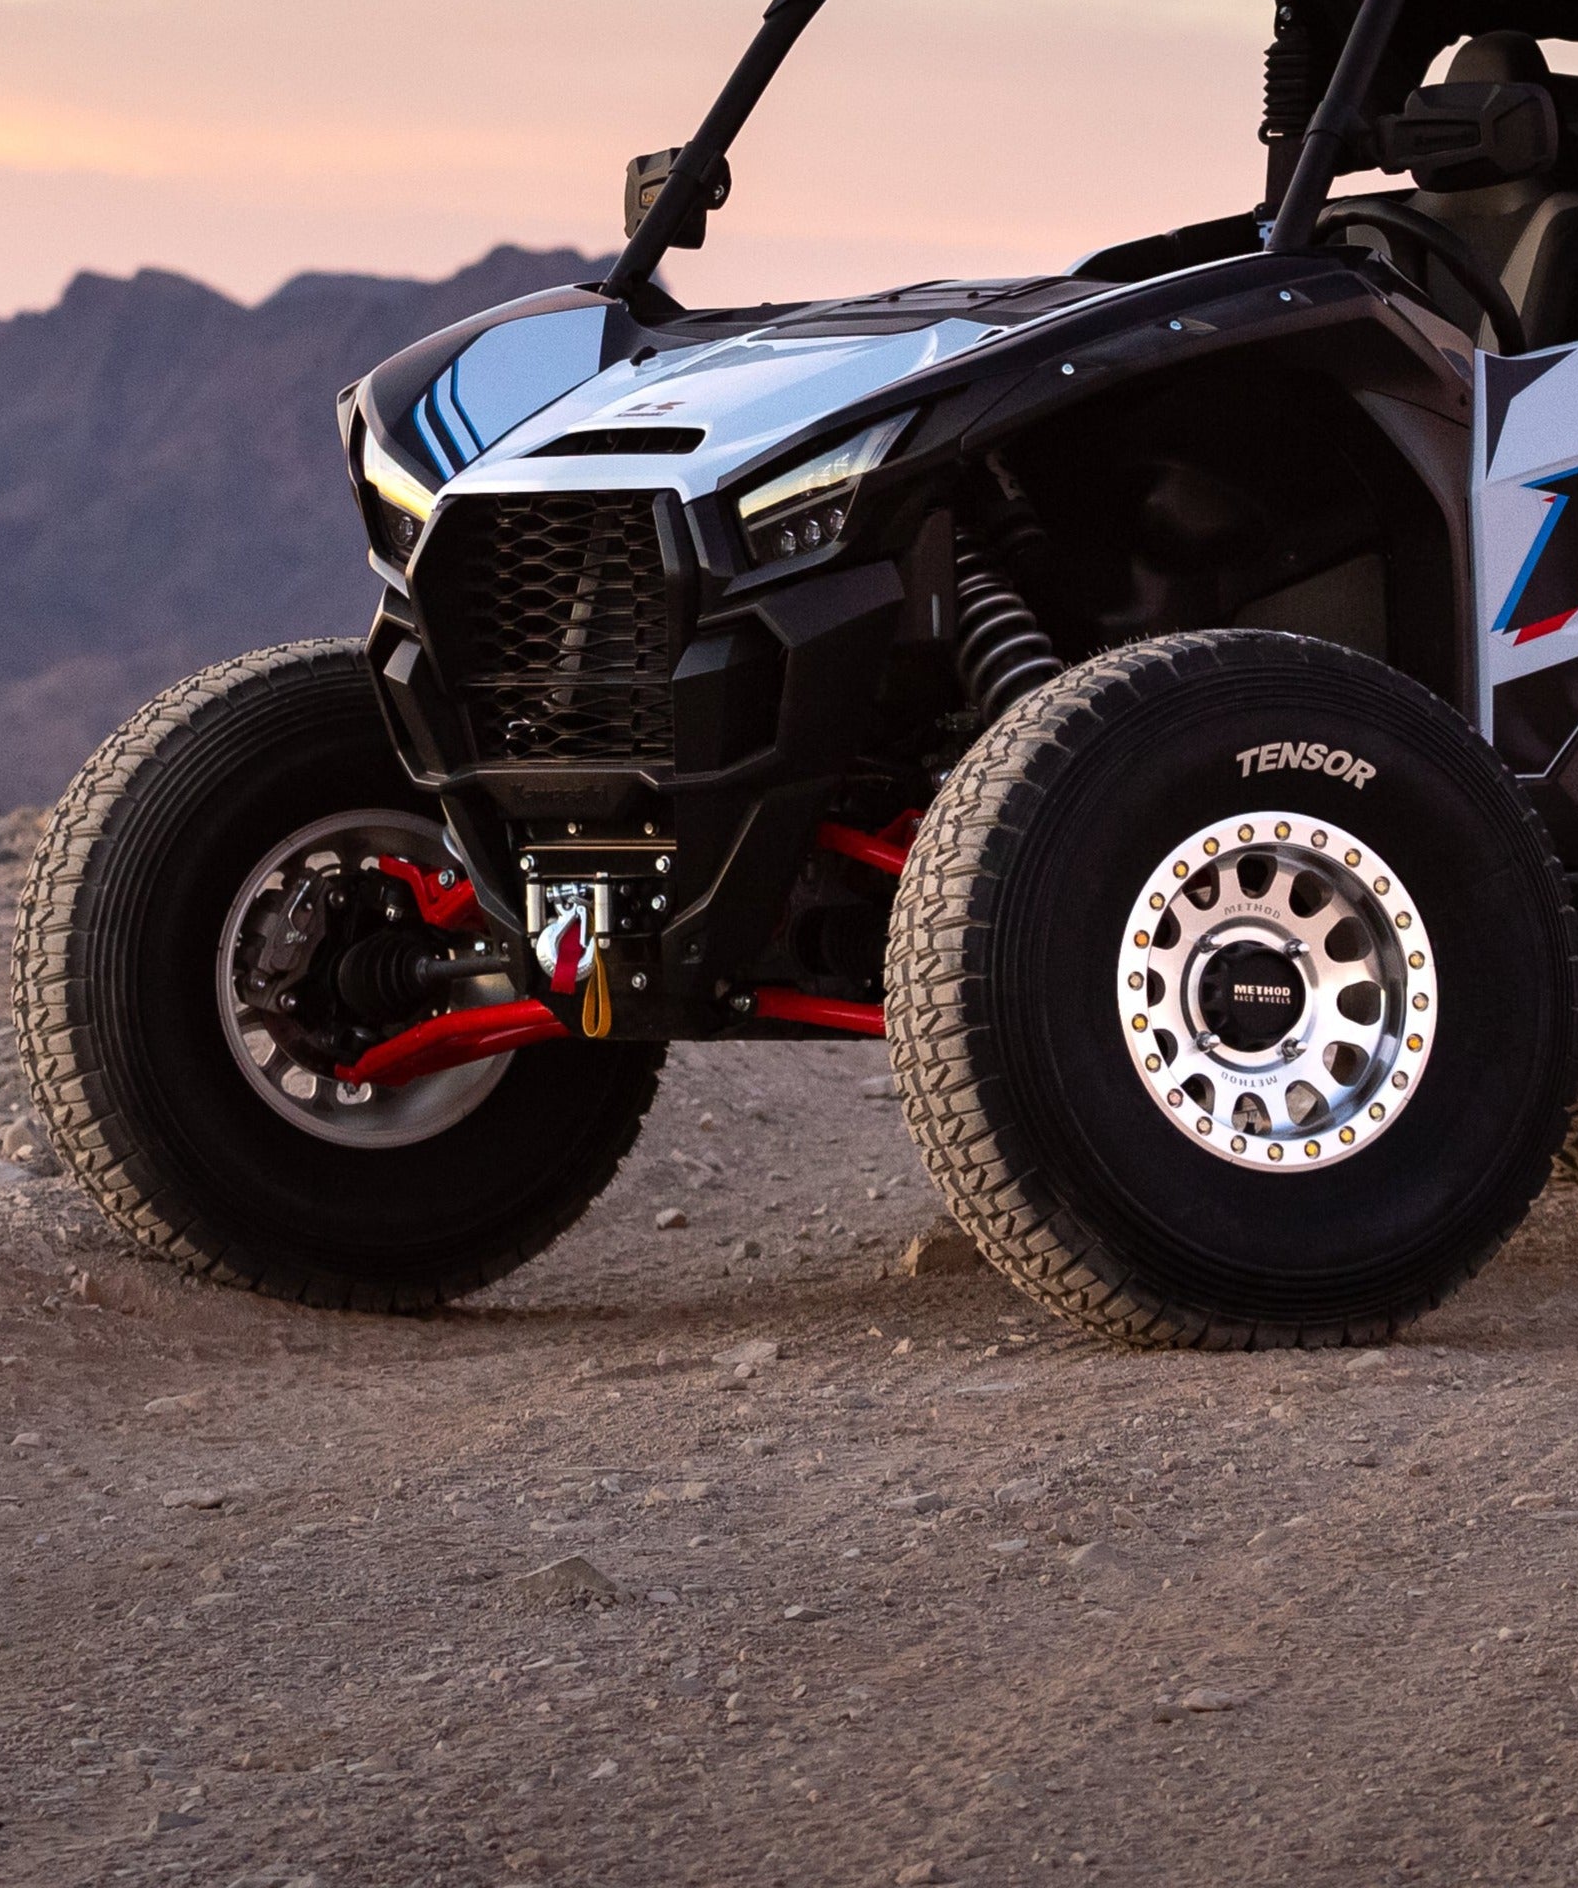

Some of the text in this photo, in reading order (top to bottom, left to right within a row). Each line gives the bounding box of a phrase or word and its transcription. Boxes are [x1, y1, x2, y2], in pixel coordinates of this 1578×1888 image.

[1236, 742, 1377, 790] TENSOR
[1224, 903, 1281, 919] METHOD
[1234, 984, 1291, 996] METHOD
[1258, 996, 1291, 1004] WHEELS
[1221, 1071, 1278, 1087] METHOD
